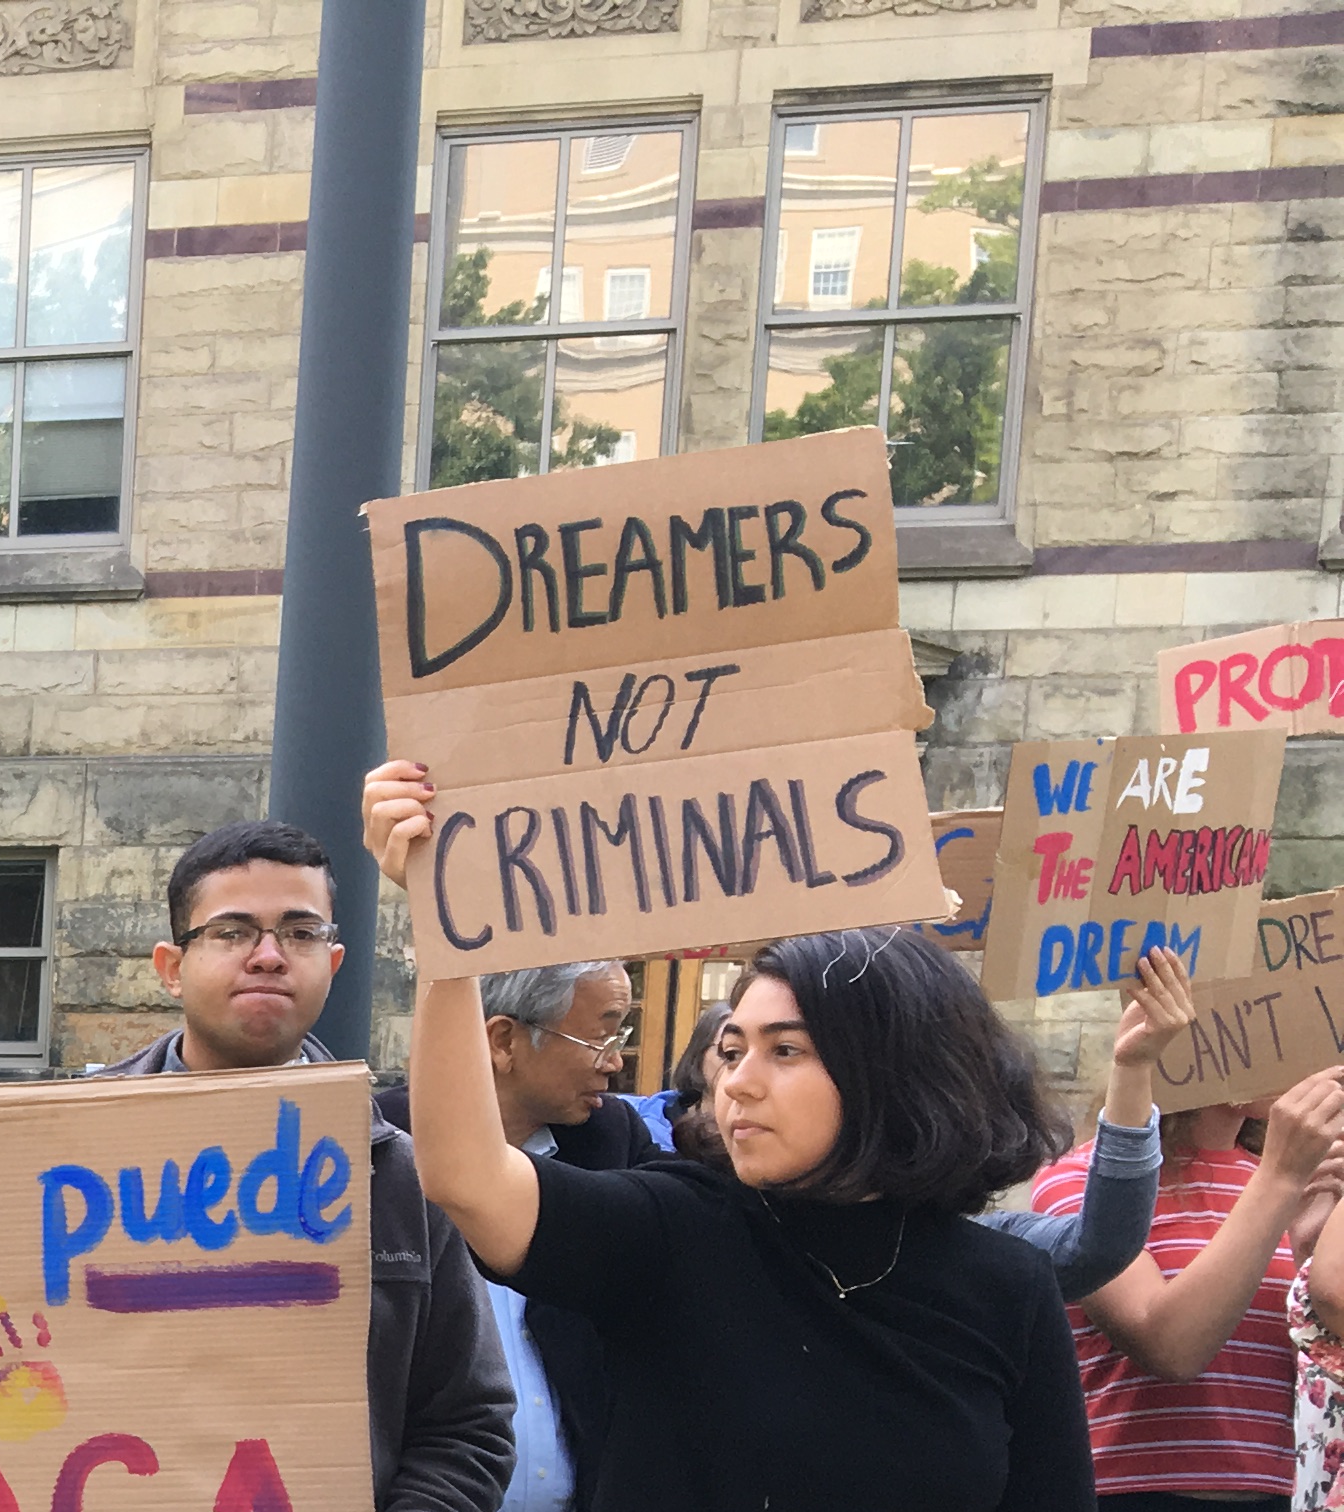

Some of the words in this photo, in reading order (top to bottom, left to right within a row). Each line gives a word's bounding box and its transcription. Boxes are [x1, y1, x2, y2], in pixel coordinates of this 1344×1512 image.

[404, 488, 874, 678] DREAMERS
[564, 664, 740, 765] NOT
[1033, 760, 1098, 816] WE
[1116, 746, 1209, 815] ARE
[433, 770, 906, 951] CRIMINALS
[1108, 824, 1271, 895] AMERICAN
[1035, 919, 1202, 997] DREAM
[39, 1097, 353, 1307] puede
[373, 1250, 422, 1263] olumbia
